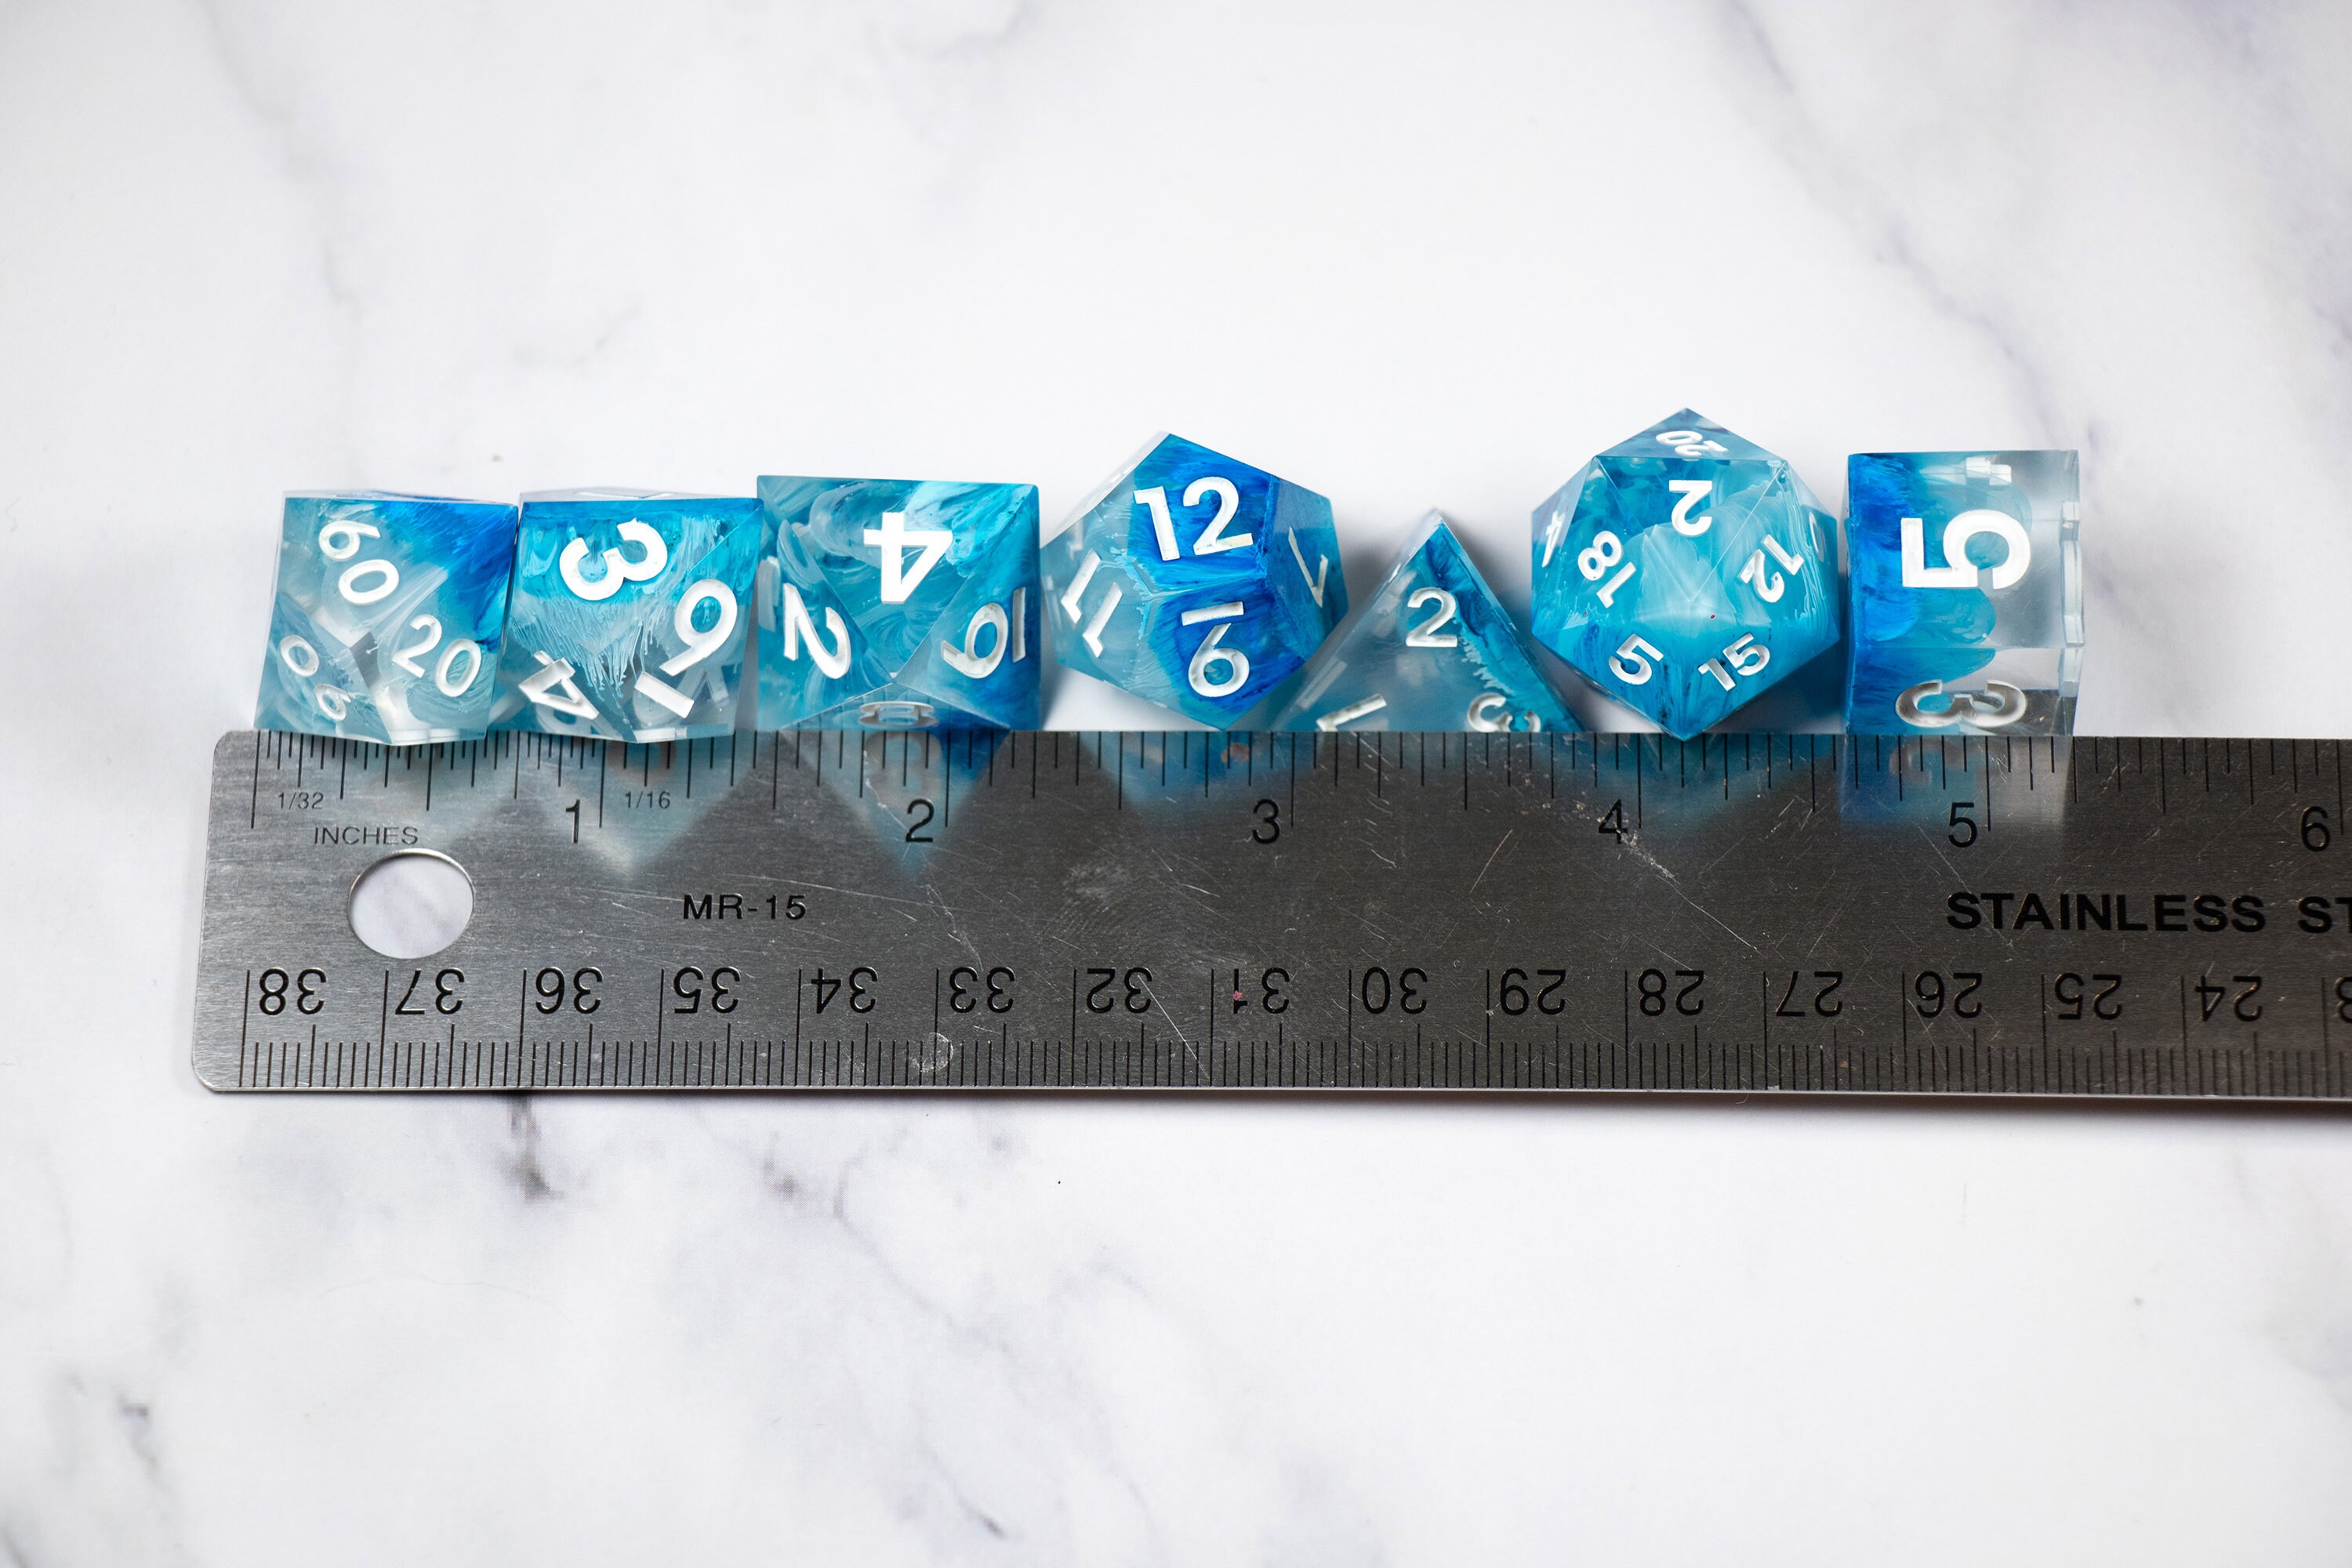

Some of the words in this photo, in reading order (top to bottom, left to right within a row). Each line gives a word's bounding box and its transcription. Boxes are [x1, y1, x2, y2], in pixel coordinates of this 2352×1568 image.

[1655, 430, 1729, 457] 20
[1134, 477, 1253, 561] 12
[1668, 480, 1712, 536] 2
[318, 520, 399, 605] 60
[560, 518, 667, 601] 3
[863, 512, 953, 604] 4
[1577, 530, 1637, 608] 18
[1738, 535, 1804, 603] 12
[1900, 509, 2031, 590] 5
[1061, 548, 1123, 658] 11
[1406, 586, 1458, 648] 2
[783, 583, 851, 680] 2
[392, 615, 482, 697] 20
[1608, 633, 1663, 684] 5
[1698, 633, 1770, 691] 15
[518, 650, 600, 720] 4
[1896, 679, 2027, 728] 3
[278, 791, 324, 810] 1/32
[565, 799, 582, 844] 1
[625, 790, 671, 809] 1/16
[905, 798, 935, 843] 2
[1253, 798, 1280, 844] 3
[1598, 799, 1628, 844] 4
[314, 826, 419, 846] INCHES
[1947, 802, 1978, 848] 5
[2300, 806, 2331, 851] 6
[683, 894, 808, 920] MR-15
[1946, 892, 2266, 932] STAINLESS
[260, 967, 327, 1016] 38
[395, 967, 466, 1016] 37
[535, 967, 604, 1014] 36
[673, 966, 741, 1014] 35
[811, 966, 878, 1014] 34
[949, 966, 1015, 1014] 33
[1087, 966, 1152, 1014] 32
[1233, 967, 1290, 1014] 31
[1362, 966, 1428, 1014] 30
[1500, 967, 1566, 1015] 29
[1637, 968, 1704, 1017] 28
[1776, 970, 1843, 1018] 27
[1914, 971, 1983, 1018] 26
[2053, 972, 2122, 1020] 25
[2195, 975, 2263, 1022] 24
